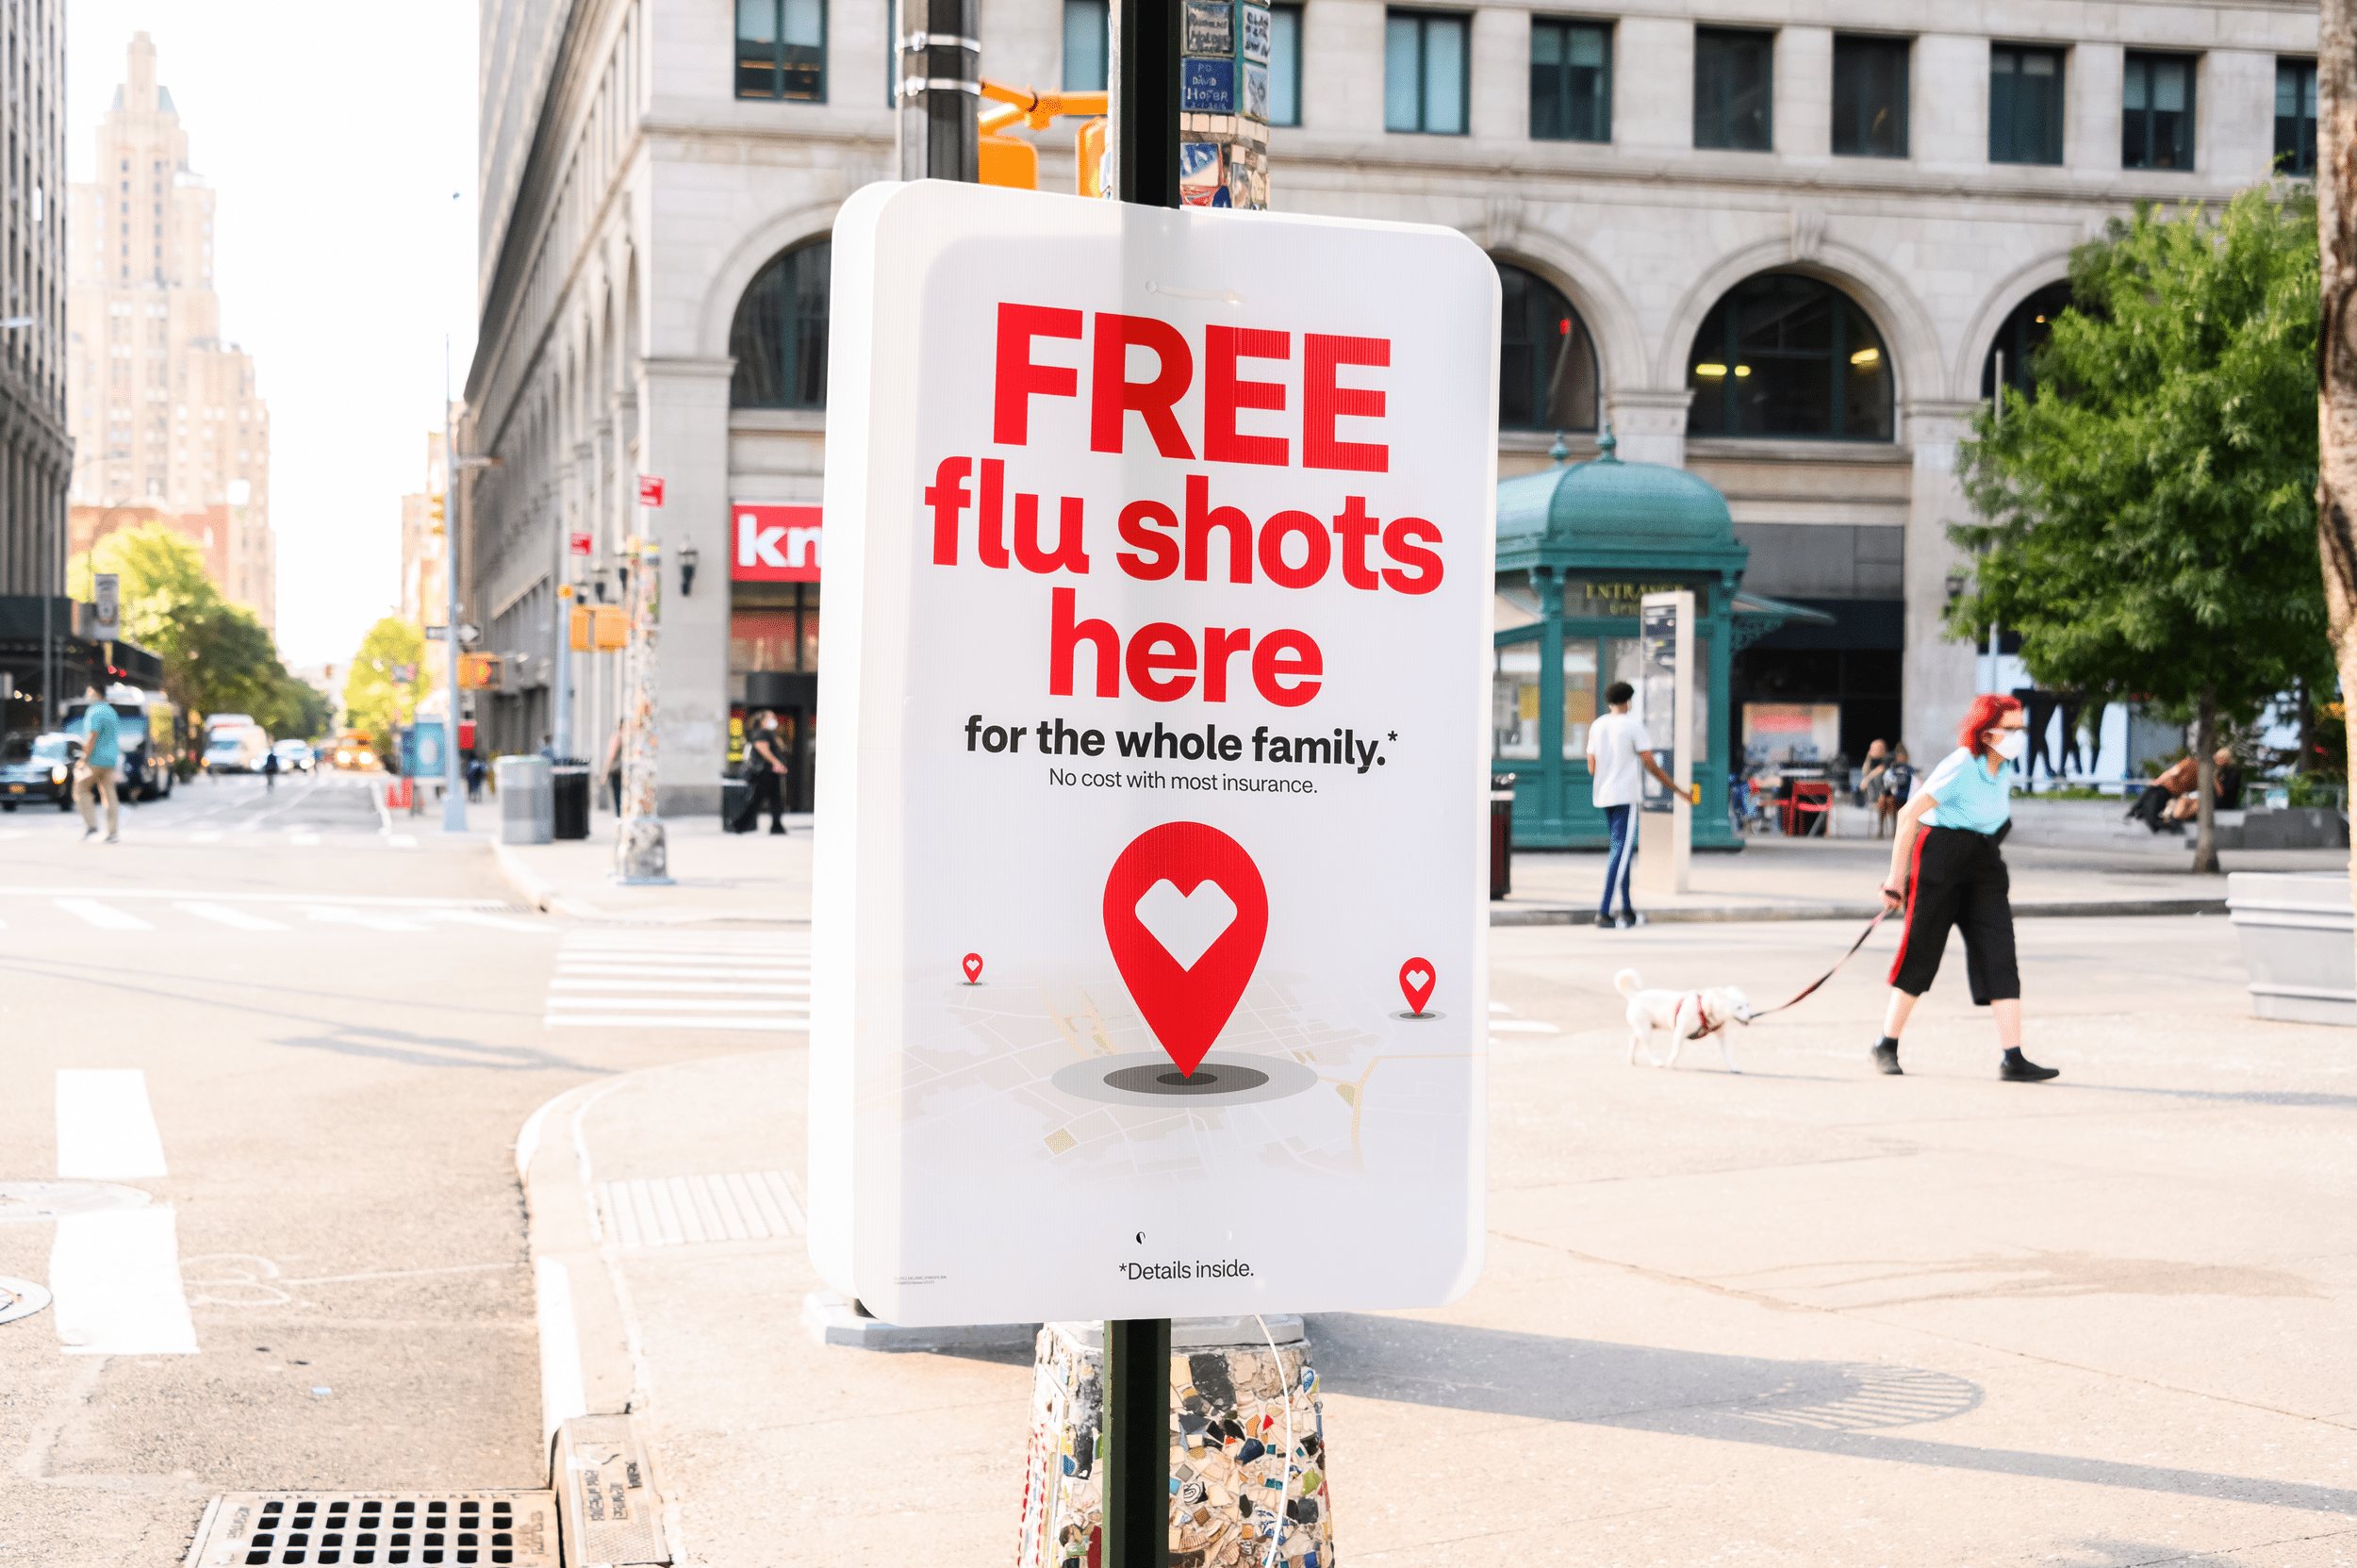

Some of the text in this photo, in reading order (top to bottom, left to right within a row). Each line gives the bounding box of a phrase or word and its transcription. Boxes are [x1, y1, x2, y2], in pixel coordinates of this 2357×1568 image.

[993, 302, 1392, 473] FREE
[924, 455, 1444, 596] flu shots
[1049, 586, 1324, 708] here
[964, 714, 1028, 753] for
[1036, 718, 1106, 757] the
[1115, 721, 1243, 762] whole
[1049, 767, 1319, 794] No cost with most insurance.
[1195, 1259, 1255, 1279] inside.
